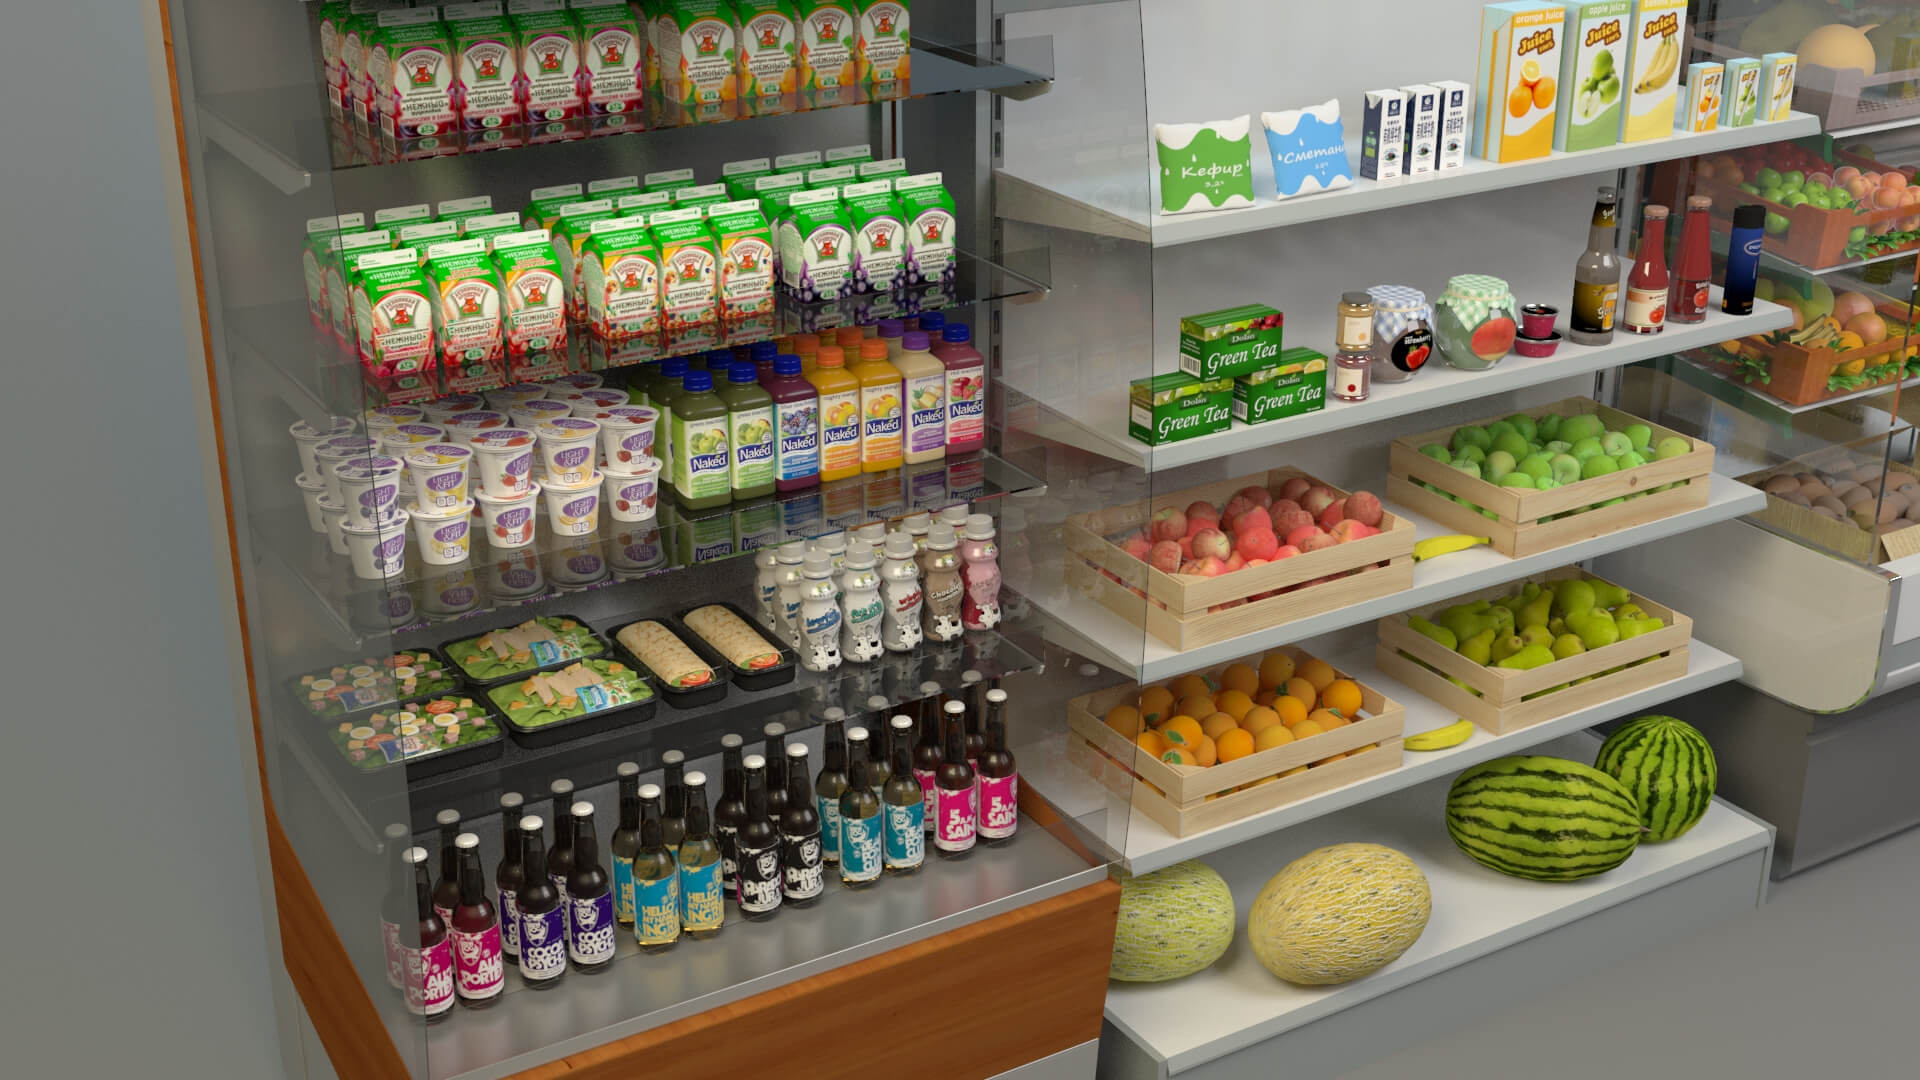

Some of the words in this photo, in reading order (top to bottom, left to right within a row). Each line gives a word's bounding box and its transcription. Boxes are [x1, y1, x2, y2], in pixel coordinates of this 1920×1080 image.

[1516, 13, 1544, 25] orange
[1545, 8, 1565, 22] juice
[1589, 5, 1609, 17] apple
[1609, 2, 1626, 15] juice
[1586, 19, 1620, 46] Juice
[1644, 12, 1677, 39] Juice
[1518, 28, 1553, 56] Juice
[1284, 144, 1345, 164] Сметан
[1182, 162, 1243, 179] Кефир
[1208, 350, 1248, 375] Green
[1252, 341, 1278, 360] Tea
[951, 401, 984, 417] Naked
[1254, 393, 1294, 418] Green
[1297, 384, 1322, 402] Tea
[914, 408, 944, 425] Naked
[1158, 414, 1201, 439] Green
[1203, 404, 1230, 424] Tea
[825, 427, 858, 444] Naked
[866, 418, 900, 435] Naked
[739, 443, 772, 462] Naked
[783, 435, 817, 453] Naked
[692, 453, 728, 471] Naked
[988, 806, 1017, 828] SAIN
[946, 818, 977, 840] SAIN
[786, 862, 824, 884] PARADO
